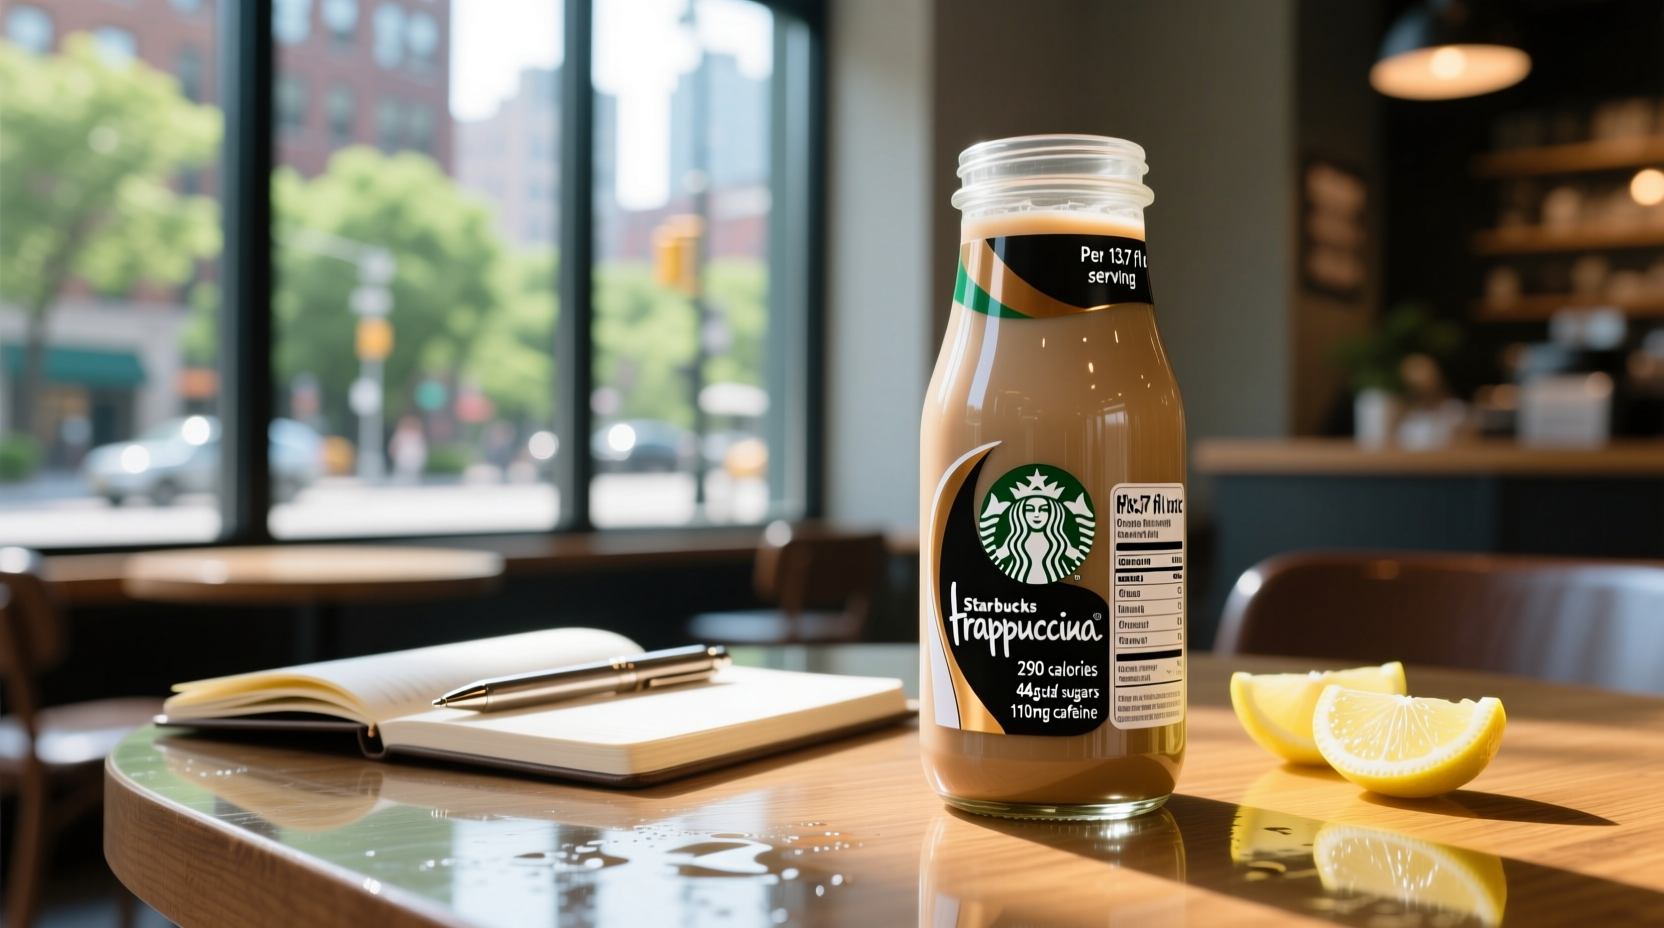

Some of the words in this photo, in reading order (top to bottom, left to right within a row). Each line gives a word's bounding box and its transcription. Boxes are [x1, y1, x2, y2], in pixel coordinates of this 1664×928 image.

[1081, 246, 1104, 263] Per
[1088, 270, 1136, 290] serving
[963, 597, 1037, 613] Starbucks
[1017, 660, 1045, 677] 290
[1048, 660, 1099, 677] calories
[1061, 688, 1100, 703] sugars
